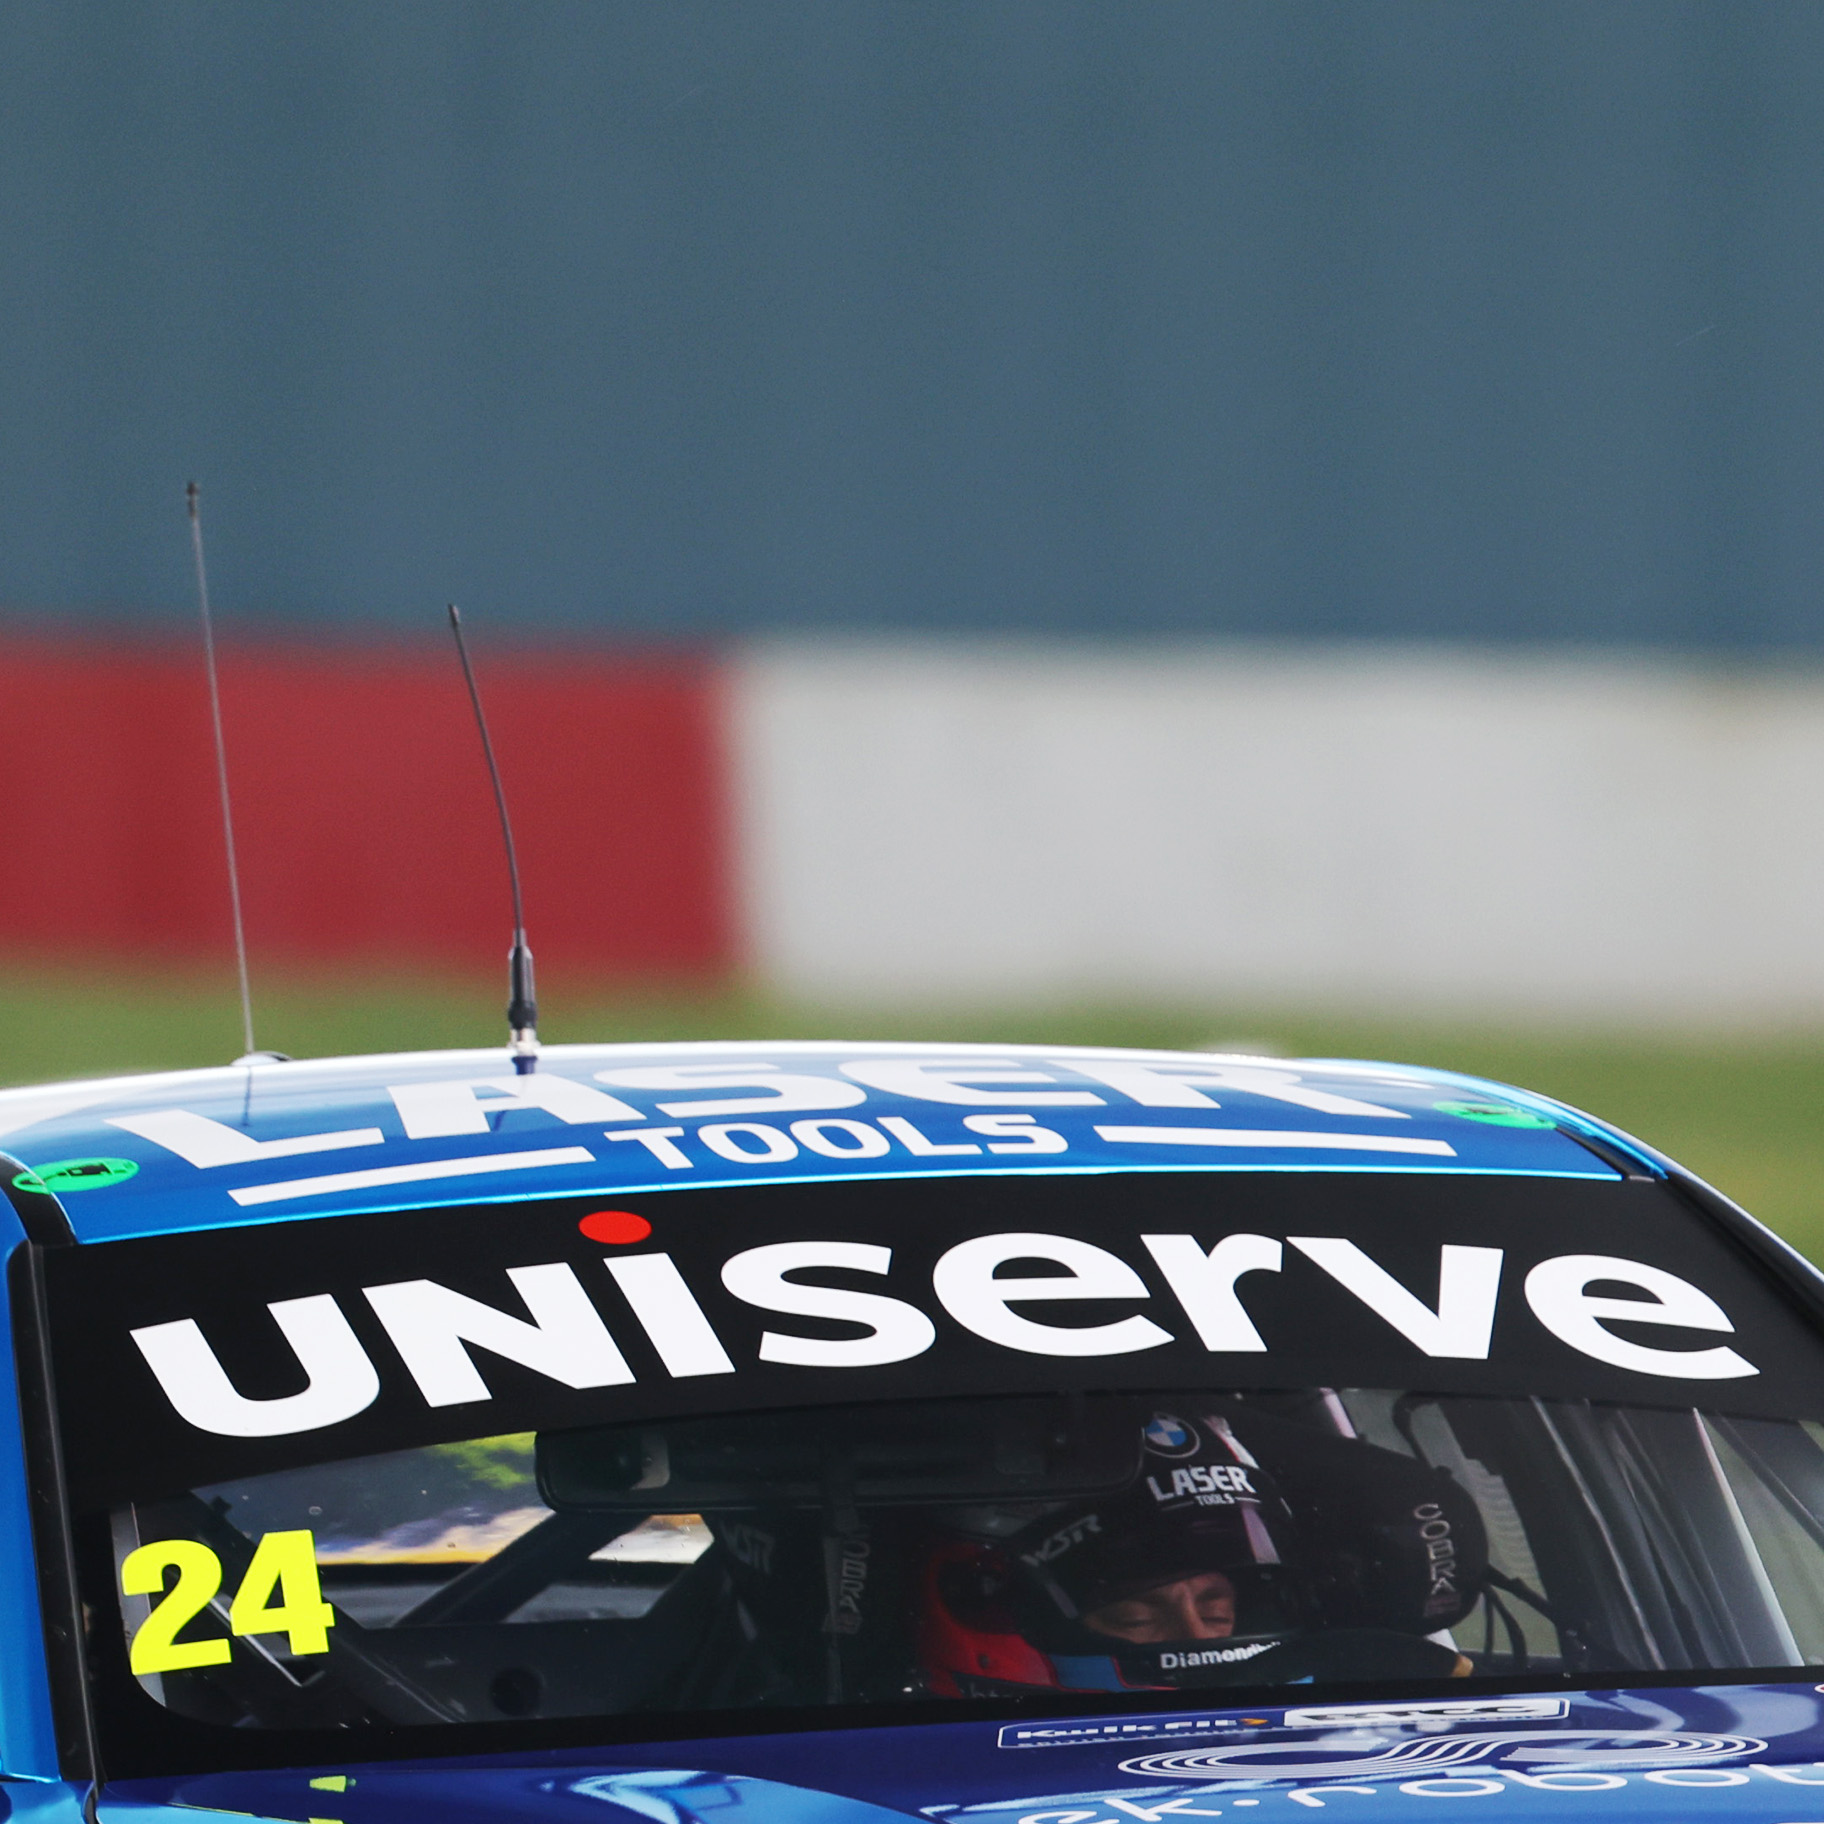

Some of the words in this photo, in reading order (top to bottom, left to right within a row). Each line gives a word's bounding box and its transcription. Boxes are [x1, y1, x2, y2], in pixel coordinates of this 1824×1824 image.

[103, 1060, 1412, 1169] LASER
[604, 1114, 1069, 1169] TOOLS
[1146, 1465, 1257, 1503] LASER
[1194, 1492, 1236, 1507] TOOLS
[1413, 1503, 1457, 1596] COBRA
[121, 1529, 335, 1677] 24
